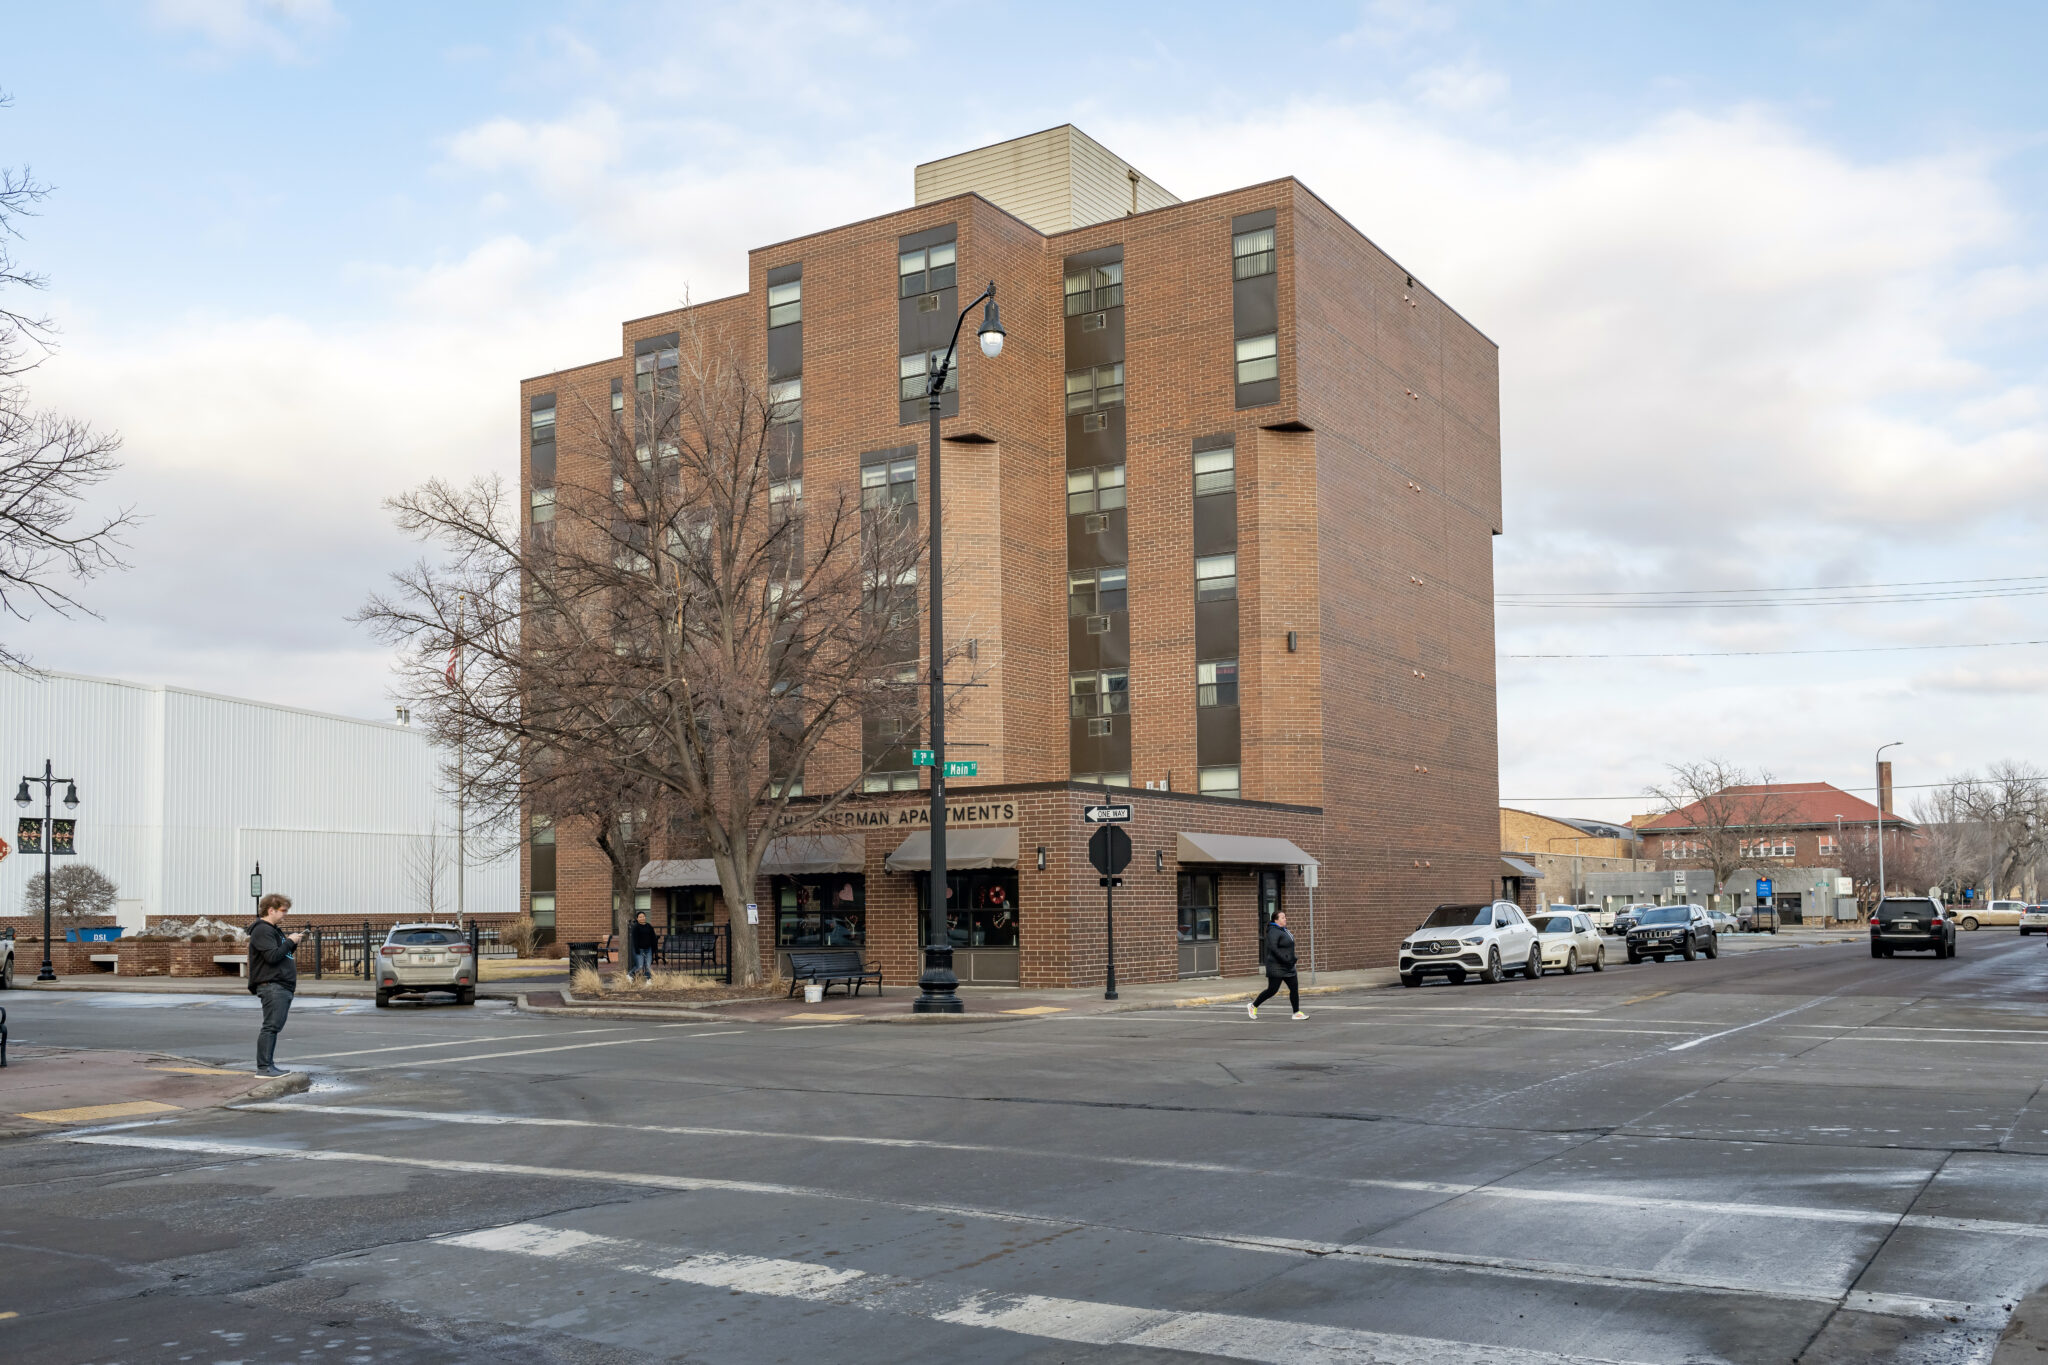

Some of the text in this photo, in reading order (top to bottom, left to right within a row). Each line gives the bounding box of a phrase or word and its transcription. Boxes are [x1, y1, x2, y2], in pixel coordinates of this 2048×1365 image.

[950, 763, 969, 775] Main
[898, 803, 1014, 825] APATMENTS
[1097, 809, 1126, 818] ONE WAY
